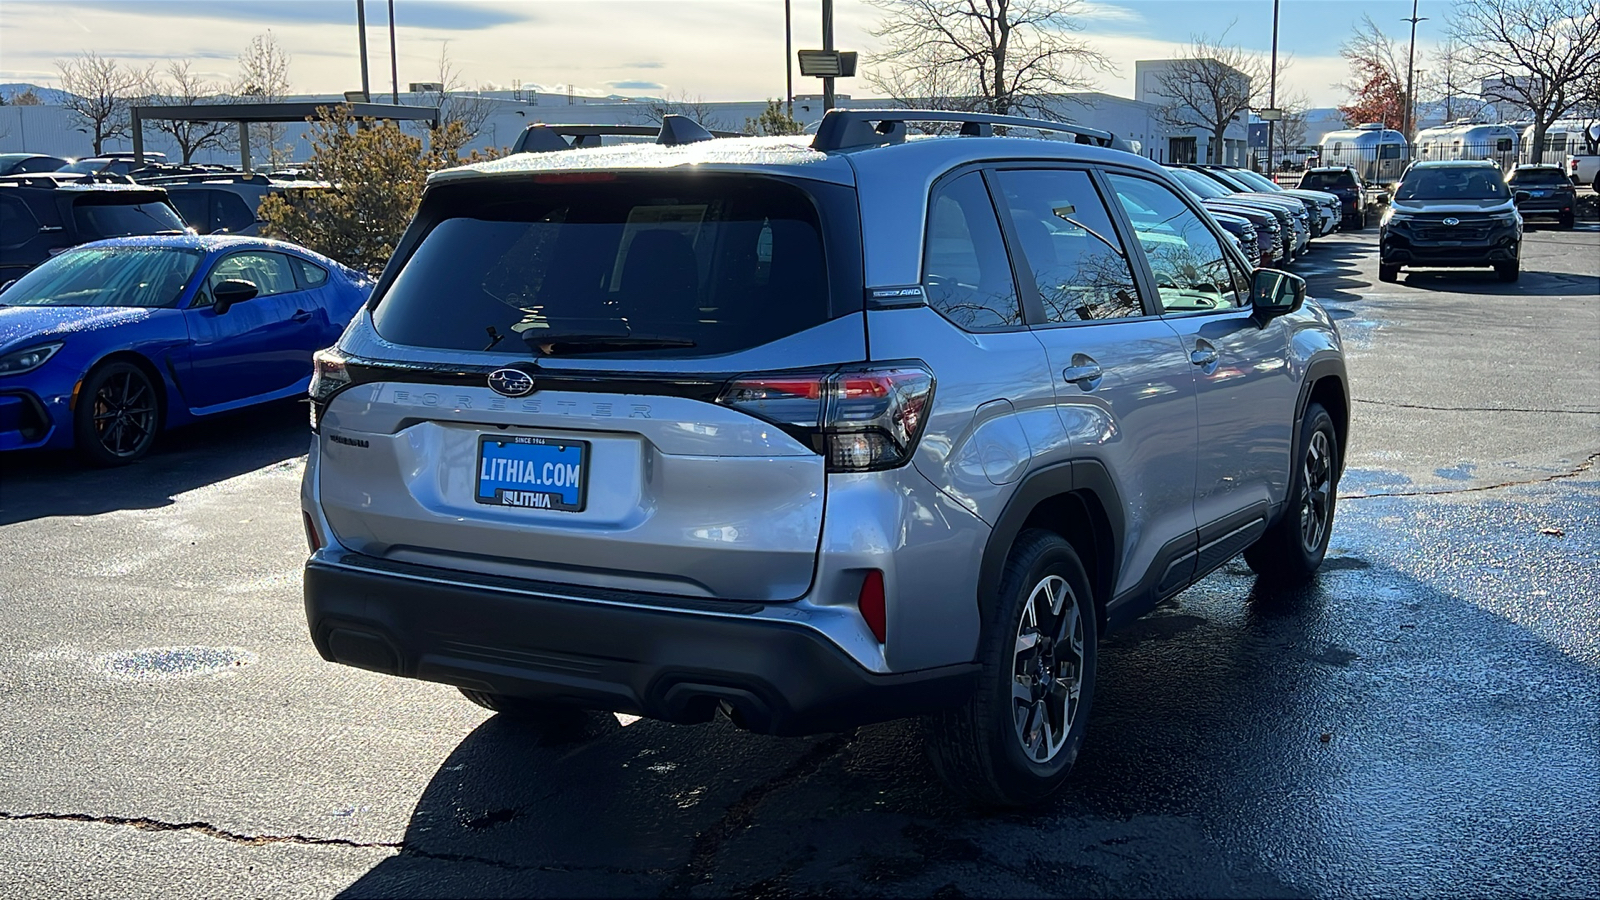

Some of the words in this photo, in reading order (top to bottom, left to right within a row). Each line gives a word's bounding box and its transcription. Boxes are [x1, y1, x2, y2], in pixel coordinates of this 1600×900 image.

[900, 288, 921, 296] AWD
[393, 390, 652, 419] FORESTER
[481, 457, 580, 488] LITHIA.COM
[513, 491, 551, 508] LITHIA
